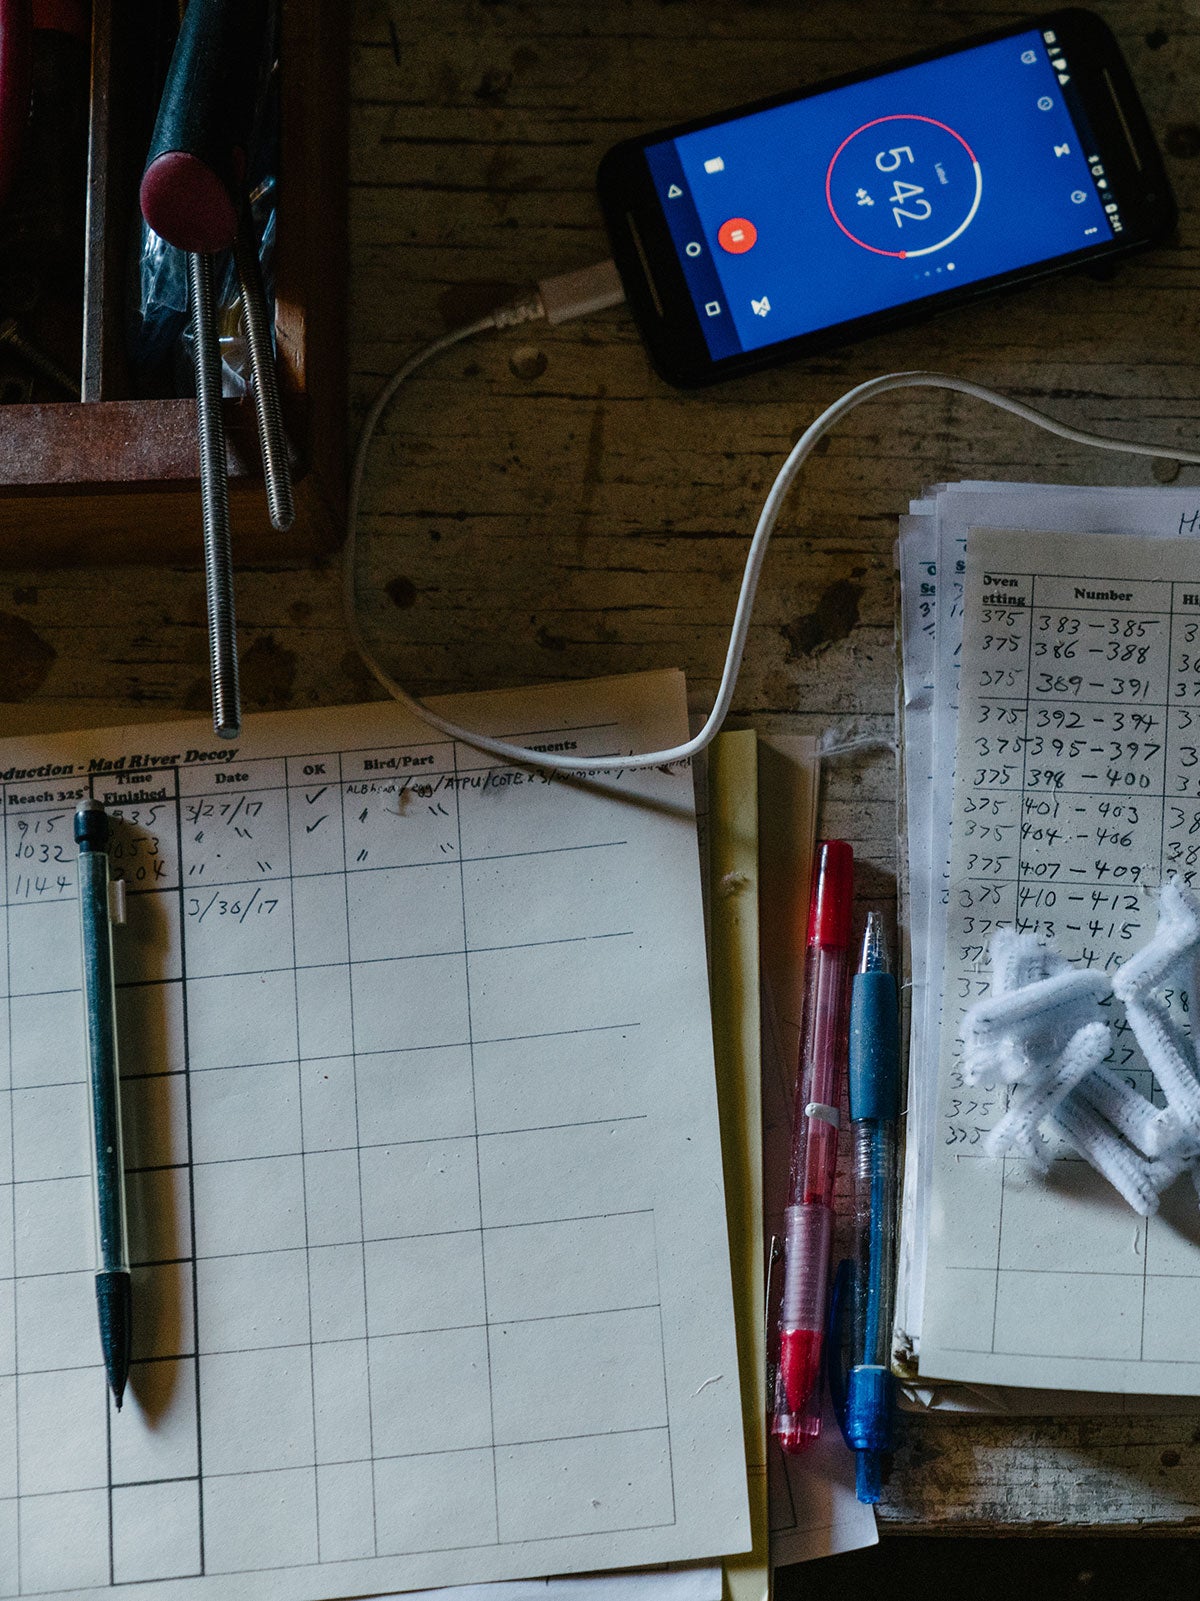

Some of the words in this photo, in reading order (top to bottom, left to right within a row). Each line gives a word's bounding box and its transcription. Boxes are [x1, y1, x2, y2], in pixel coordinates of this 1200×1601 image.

[889, 180, 932, 229] 42
[1074, 587, 1134, 602] Number
[981, 609, 1024, 627] 375
[982, 634, 1022, 652] 375
[979, 669, 1025, 687] 375
[977, 705, 1028, 725] 375
[974, 737, 1027, 757] 375
[87, 758, 125, 773] Mad
[127, 754, 180, 769] River
[183, 748, 240, 763] Decoy
[303, 763, 326, 776] OK
[363, 753, 434, 771] Bird/Part
[115, 773, 153, 785] Time
[215, 772, 249, 784] Date
[973, 765, 1018, 786] 375
[8, 792, 54, 806] Reach
[103, 788, 167, 804] Finished
[964, 797, 1007, 815] 375
[18, 814, 66, 839] 915
[185, 795, 263, 826] 3/27/17
[964, 819, 1016, 842] 375
[15, 841, 75, 863] 1032
[966, 853, 1012, 874] 375
[14, 874, 72, 898] 1144
[188, 888, 279, 923] 3/30/17
[959, 885, 1008, 909] 375
[944, 1099, 994, 1119] 375
[944, 1125, 991, 1146] 375
